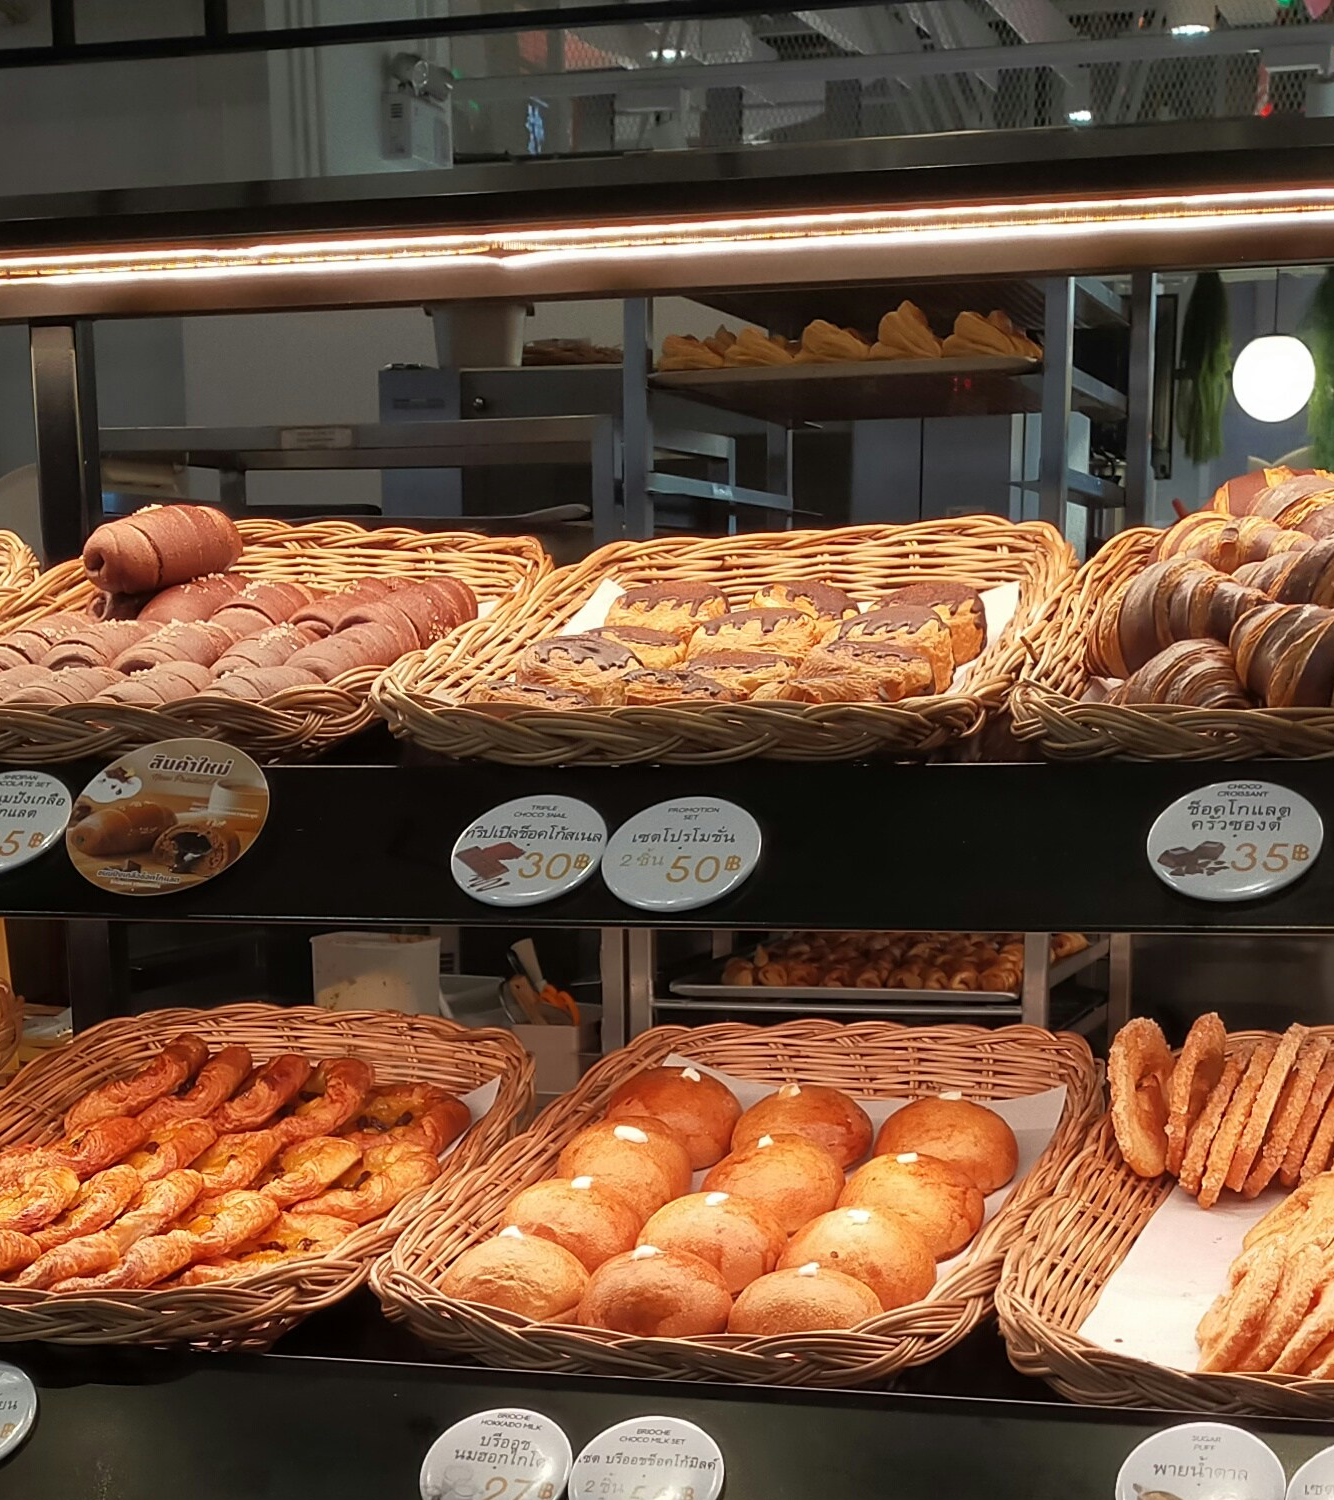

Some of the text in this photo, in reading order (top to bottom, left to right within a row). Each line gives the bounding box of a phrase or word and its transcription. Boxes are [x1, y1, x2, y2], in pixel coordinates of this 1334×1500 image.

[619, 855, 632, 867] 2
[619, 1436, 686, 1446] CHOCO MILK SET
[1191, 1434, 1221, 1442] SUGAR
[584, 1480, 596, 1494] 2
